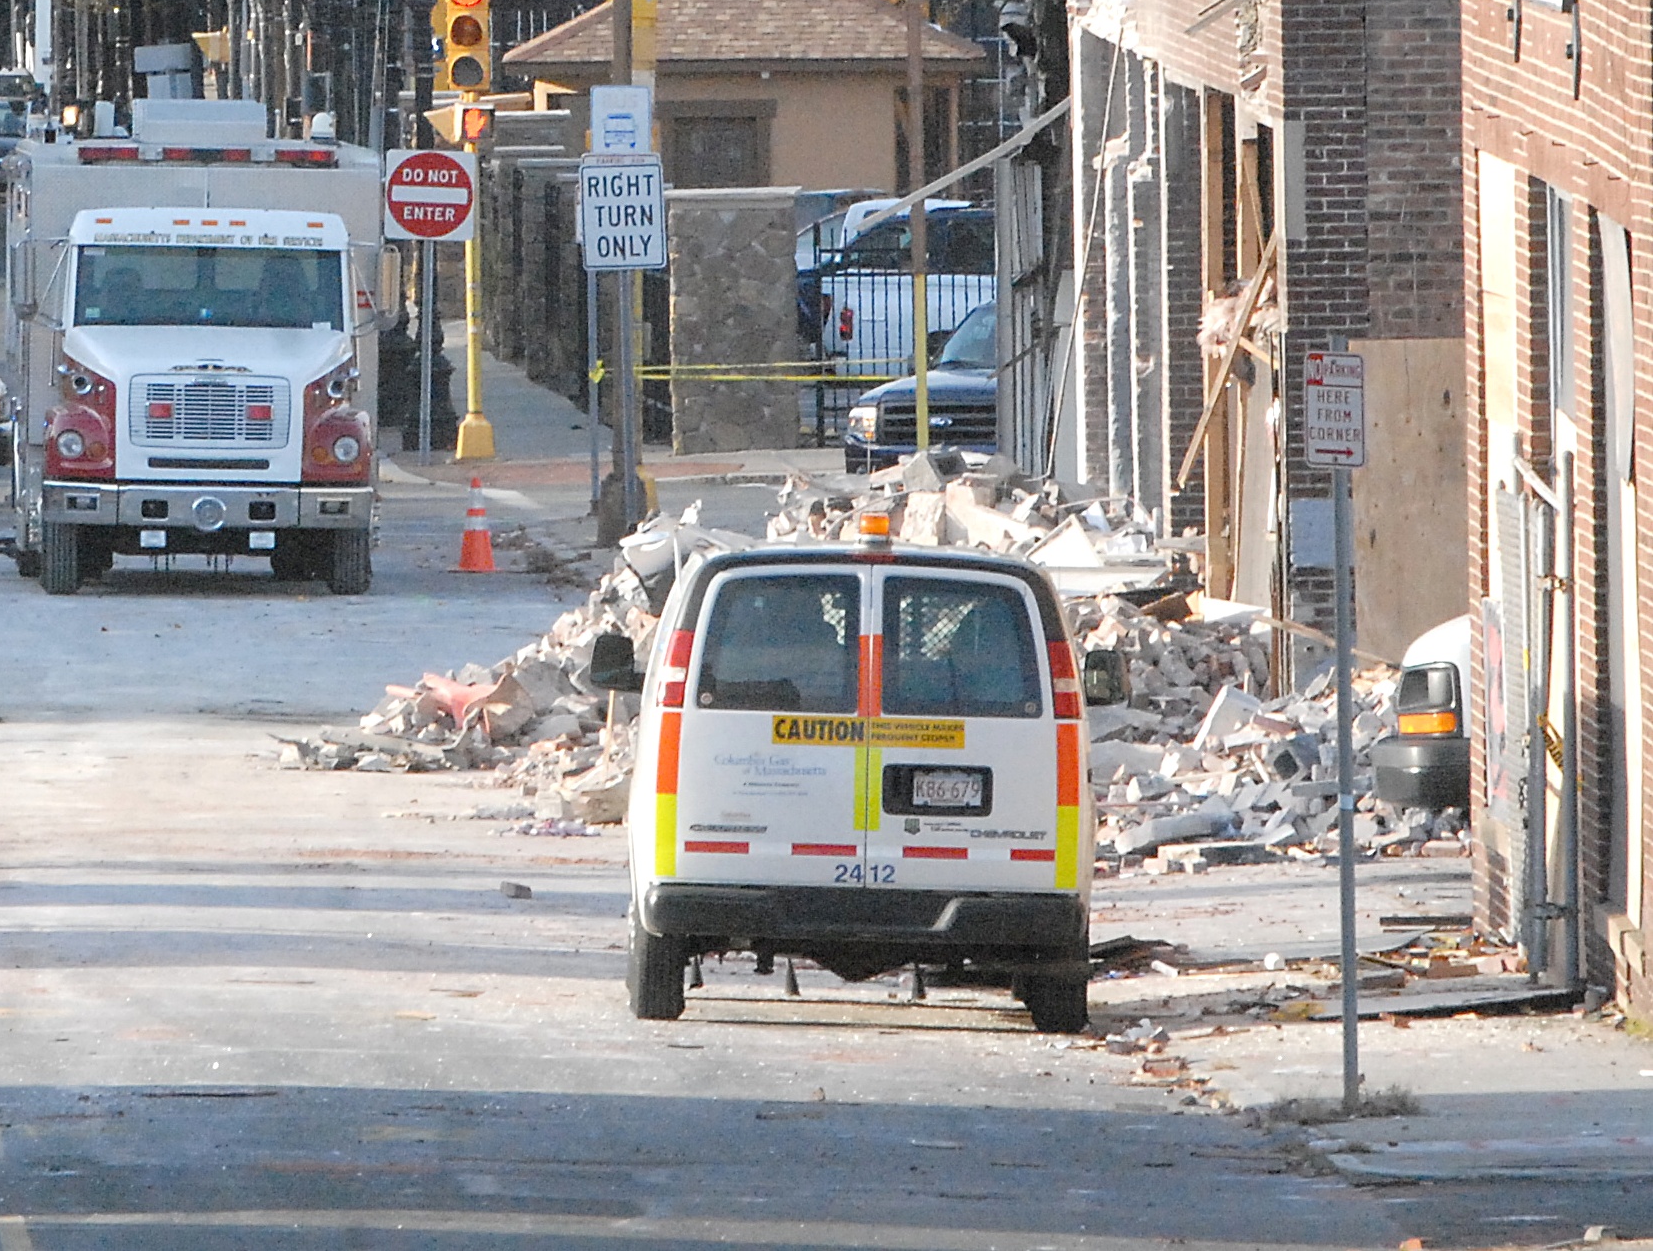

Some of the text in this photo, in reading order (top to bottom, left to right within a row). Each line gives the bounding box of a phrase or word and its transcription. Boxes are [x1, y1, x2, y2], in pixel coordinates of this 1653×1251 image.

[402, 168, 458, 184] DO NOT
[588, 174, 653, 198] RIGHT
[403, 206, 455, 221] ENTER
[595, 205, 653, 227] TURN
[597, 234, 652, 260] ONLY
[1317, 390, 1351, 404] HERE
[1317, 409, 1352, 423] FROM
[1309, 426, 1361, 442] CORNER
[774, 719, 865, 742] CAUTION
